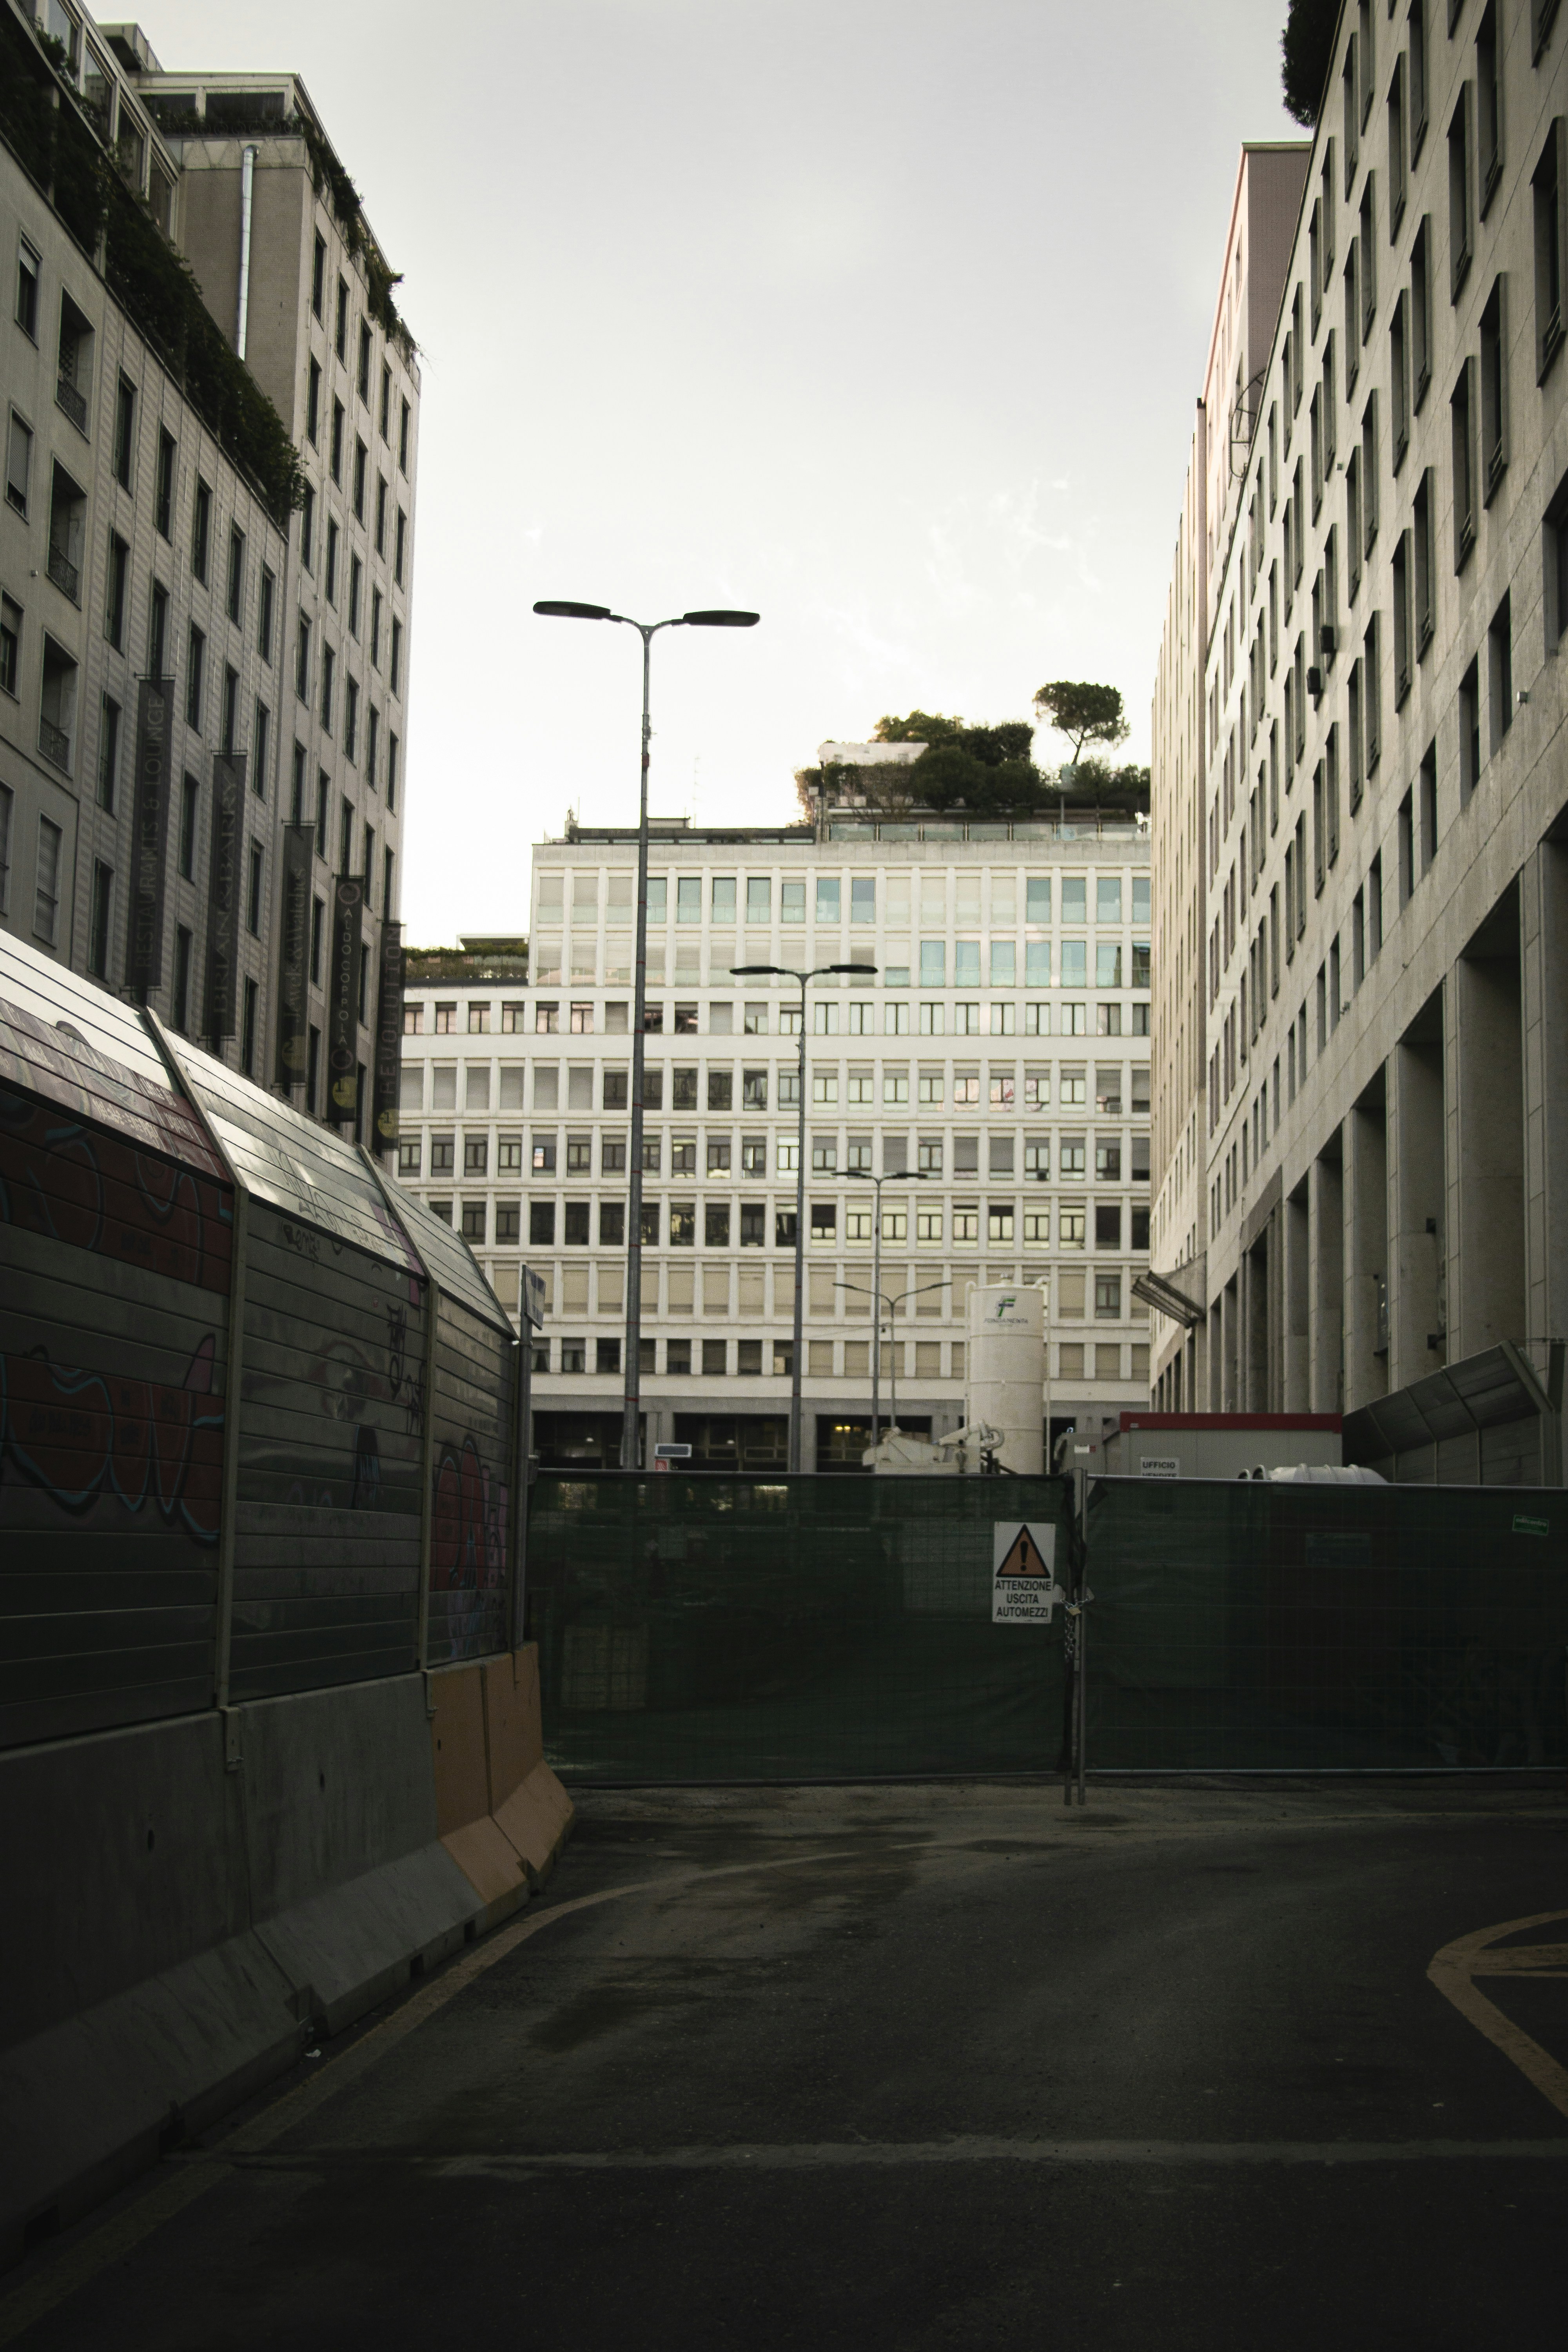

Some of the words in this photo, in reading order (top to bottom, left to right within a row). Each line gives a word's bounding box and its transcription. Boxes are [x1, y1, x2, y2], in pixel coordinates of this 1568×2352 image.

[144, 697, 165, 786] LOUNGE
[134, 821, 159, 968] RESTAURANTS
[341, 908, 353, 955] ALDO
[339, 960, 350, 1045] COPPOLA
[379, 926, 401, 1094] REVOLUTION
[995, 1580, 1051, 1591] ATTENZIONE
[996, 1607, 1048, 1617] AUTOMEZZI
[1006, 1593, 1038, 1604] USCITA
